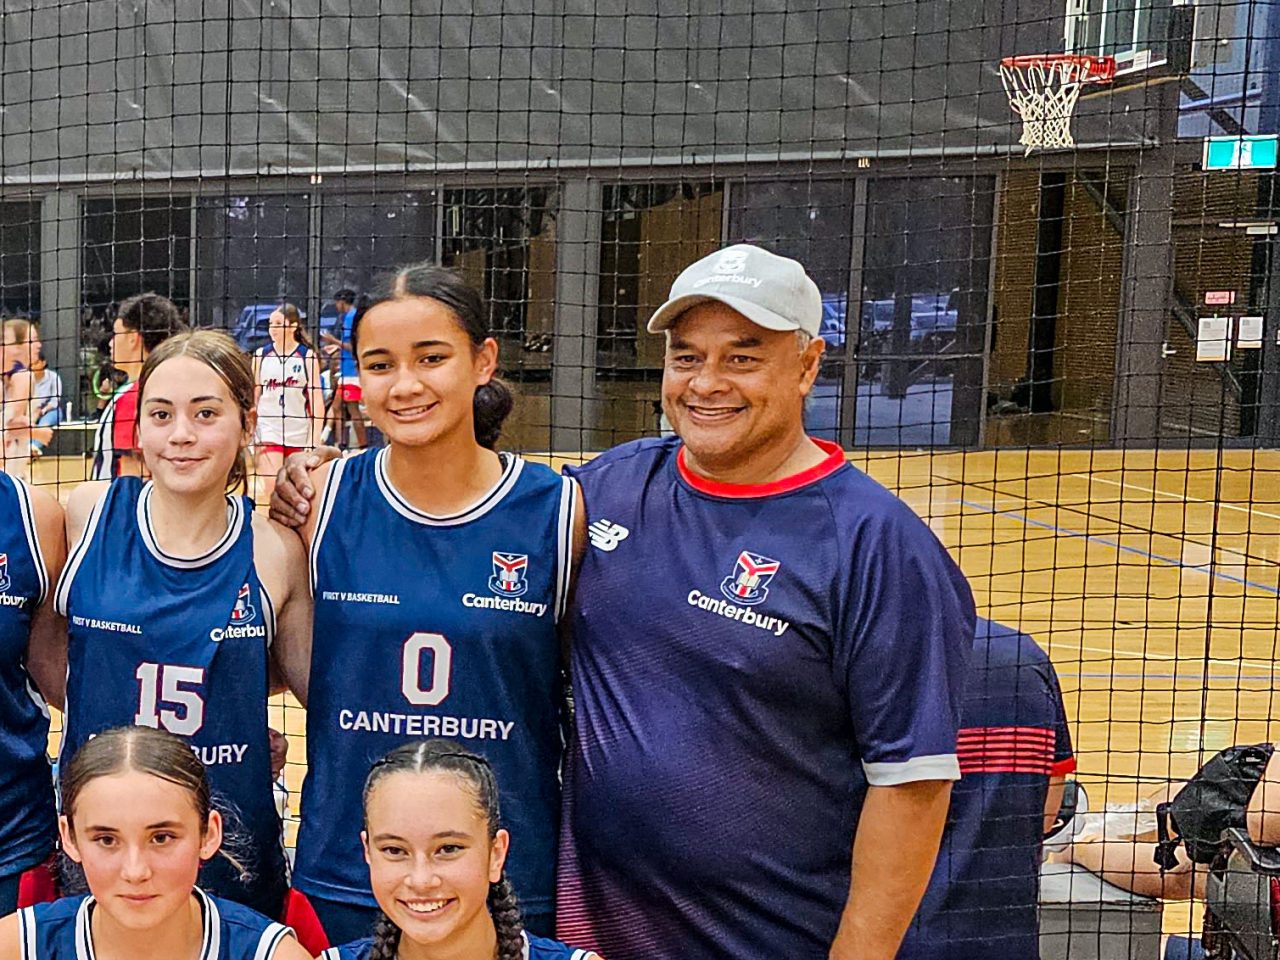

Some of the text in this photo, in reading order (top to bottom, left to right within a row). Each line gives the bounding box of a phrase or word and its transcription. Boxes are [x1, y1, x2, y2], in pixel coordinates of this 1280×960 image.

[340, 591, 347, 600] V
[347, 593, 400, 605] BASKETBALL
[462, 592, 547, 617] Canterbury
[687, 589, 790, 636] Canterbury
[90, 619, 142, 634] BASKETBALL
[401, 631, 452, 706] 0
[134, 661, 205, 736] 15
[339, 709, 515, 740] CANTERBURY
